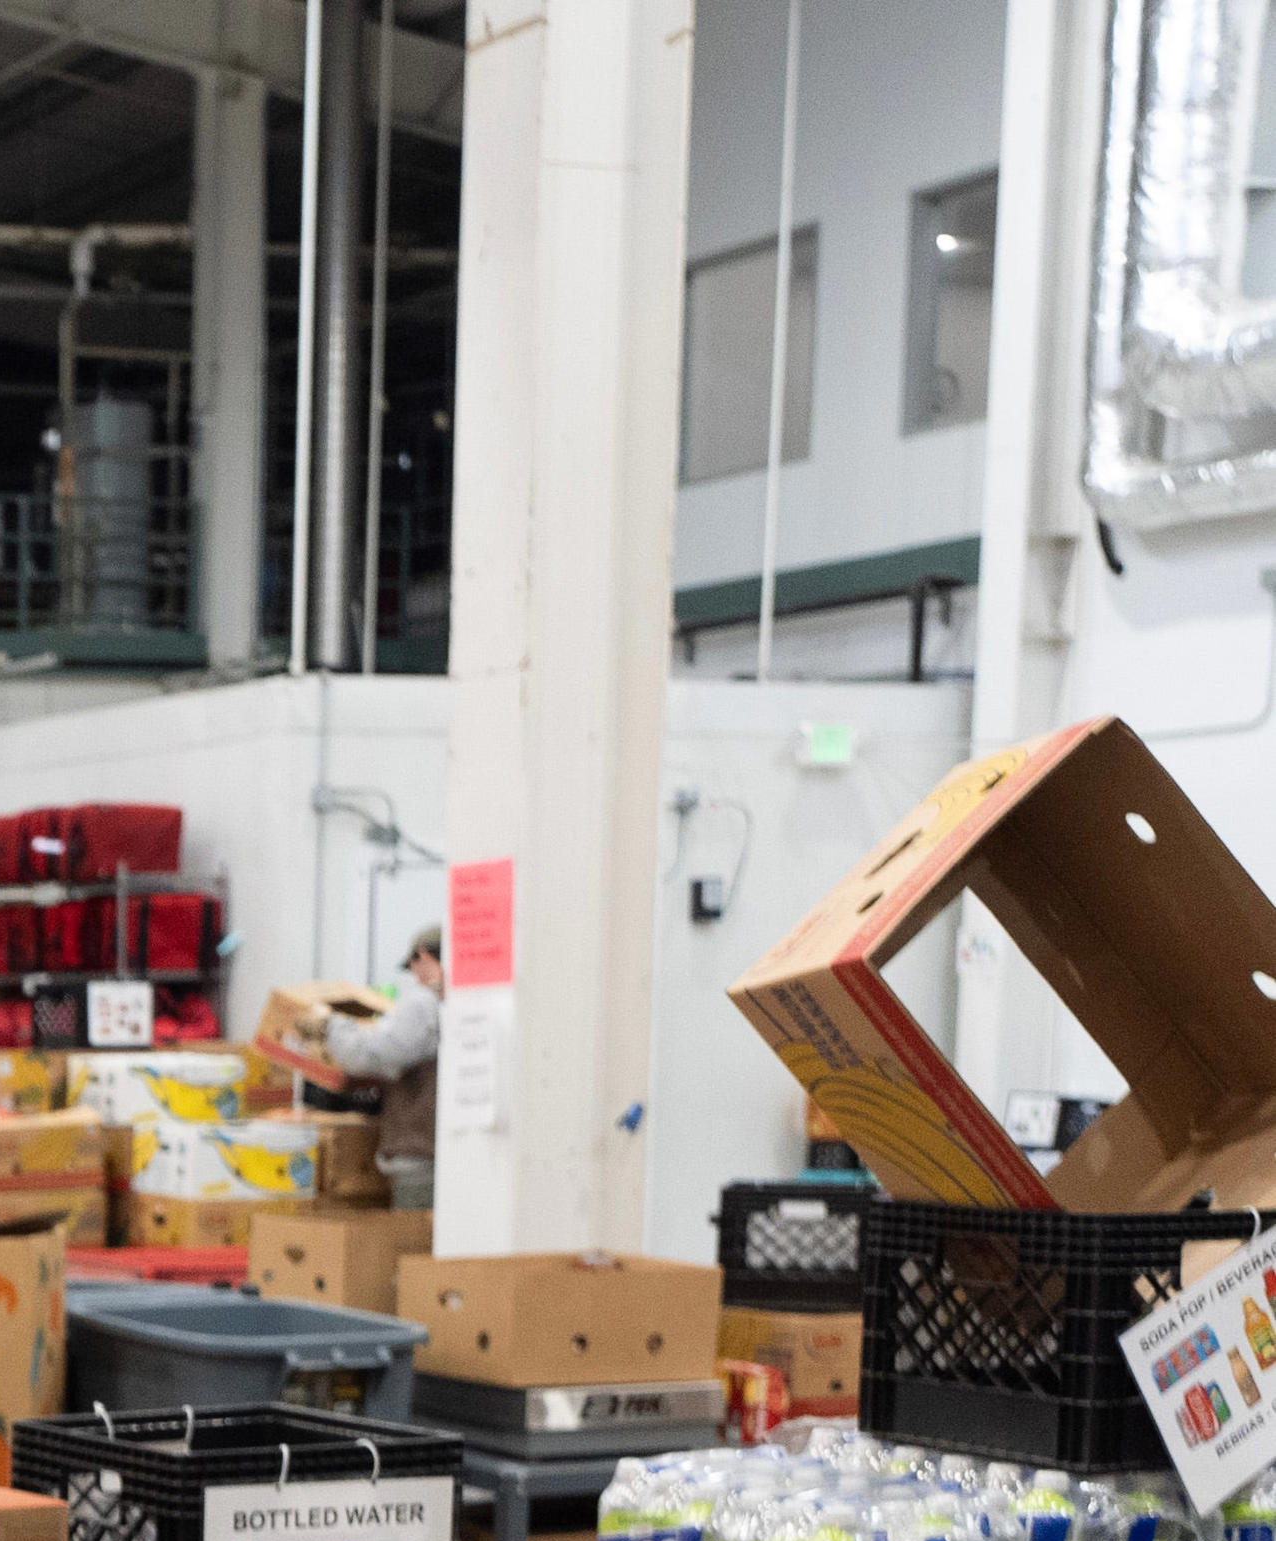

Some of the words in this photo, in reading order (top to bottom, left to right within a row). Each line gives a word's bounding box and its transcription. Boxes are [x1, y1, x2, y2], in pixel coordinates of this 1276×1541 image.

[1139, 1319, 1177, 1352] SODA
[1179, 1295, 1207, 1325] POP
[1215, 1415, 1264, 1459] BEBIDAS
[233, 1508, 339, 1532] BOTTLED
[345, 1503, 425, 1526] WATER
